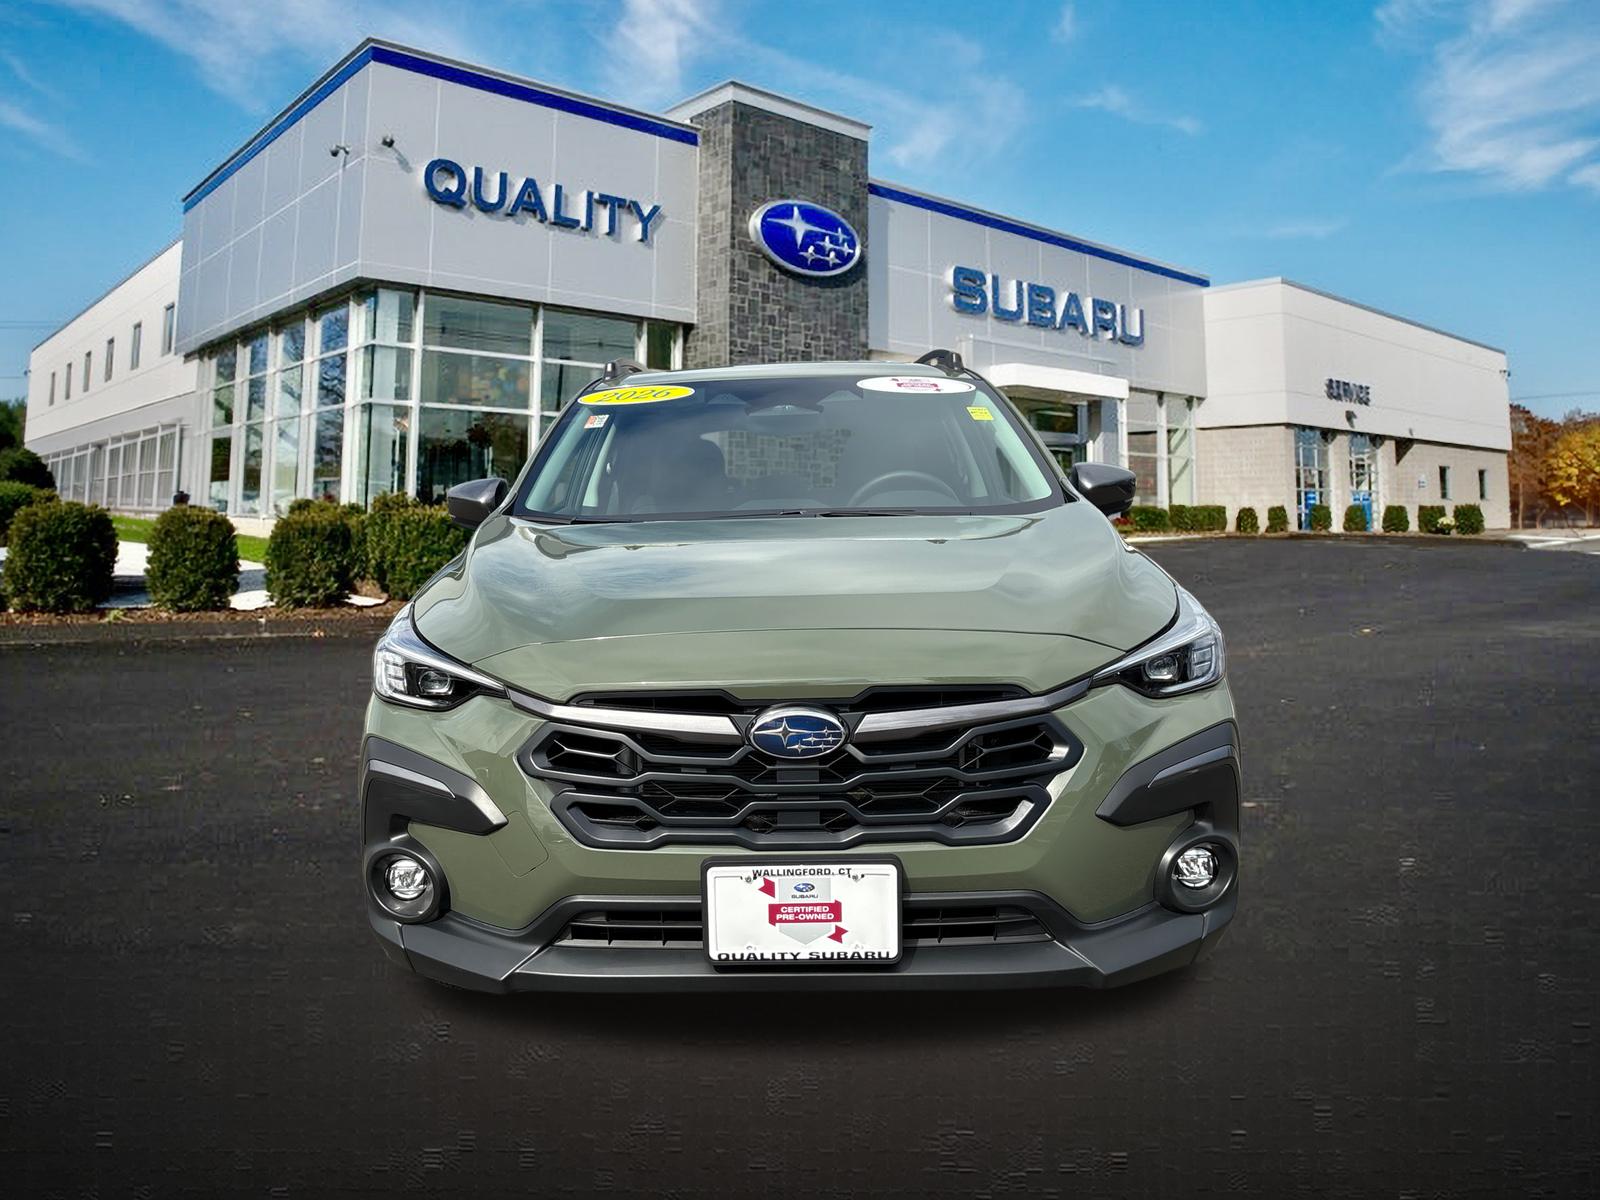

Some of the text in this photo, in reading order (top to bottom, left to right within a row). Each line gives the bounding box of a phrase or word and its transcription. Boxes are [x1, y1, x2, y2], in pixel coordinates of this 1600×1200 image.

[424, 158, 662, 244] QUALITY
[951, 265, 1145, 347] SUBARU
[597, 388, 674, 402] 2026
[1325, 378, 1371, 406] SERVICE
[838, 867, 852, 876] CT
[776, 913, 835, 921] PRE-OWNED
[717, 951, 890, 961] QUALITY SUBARU
